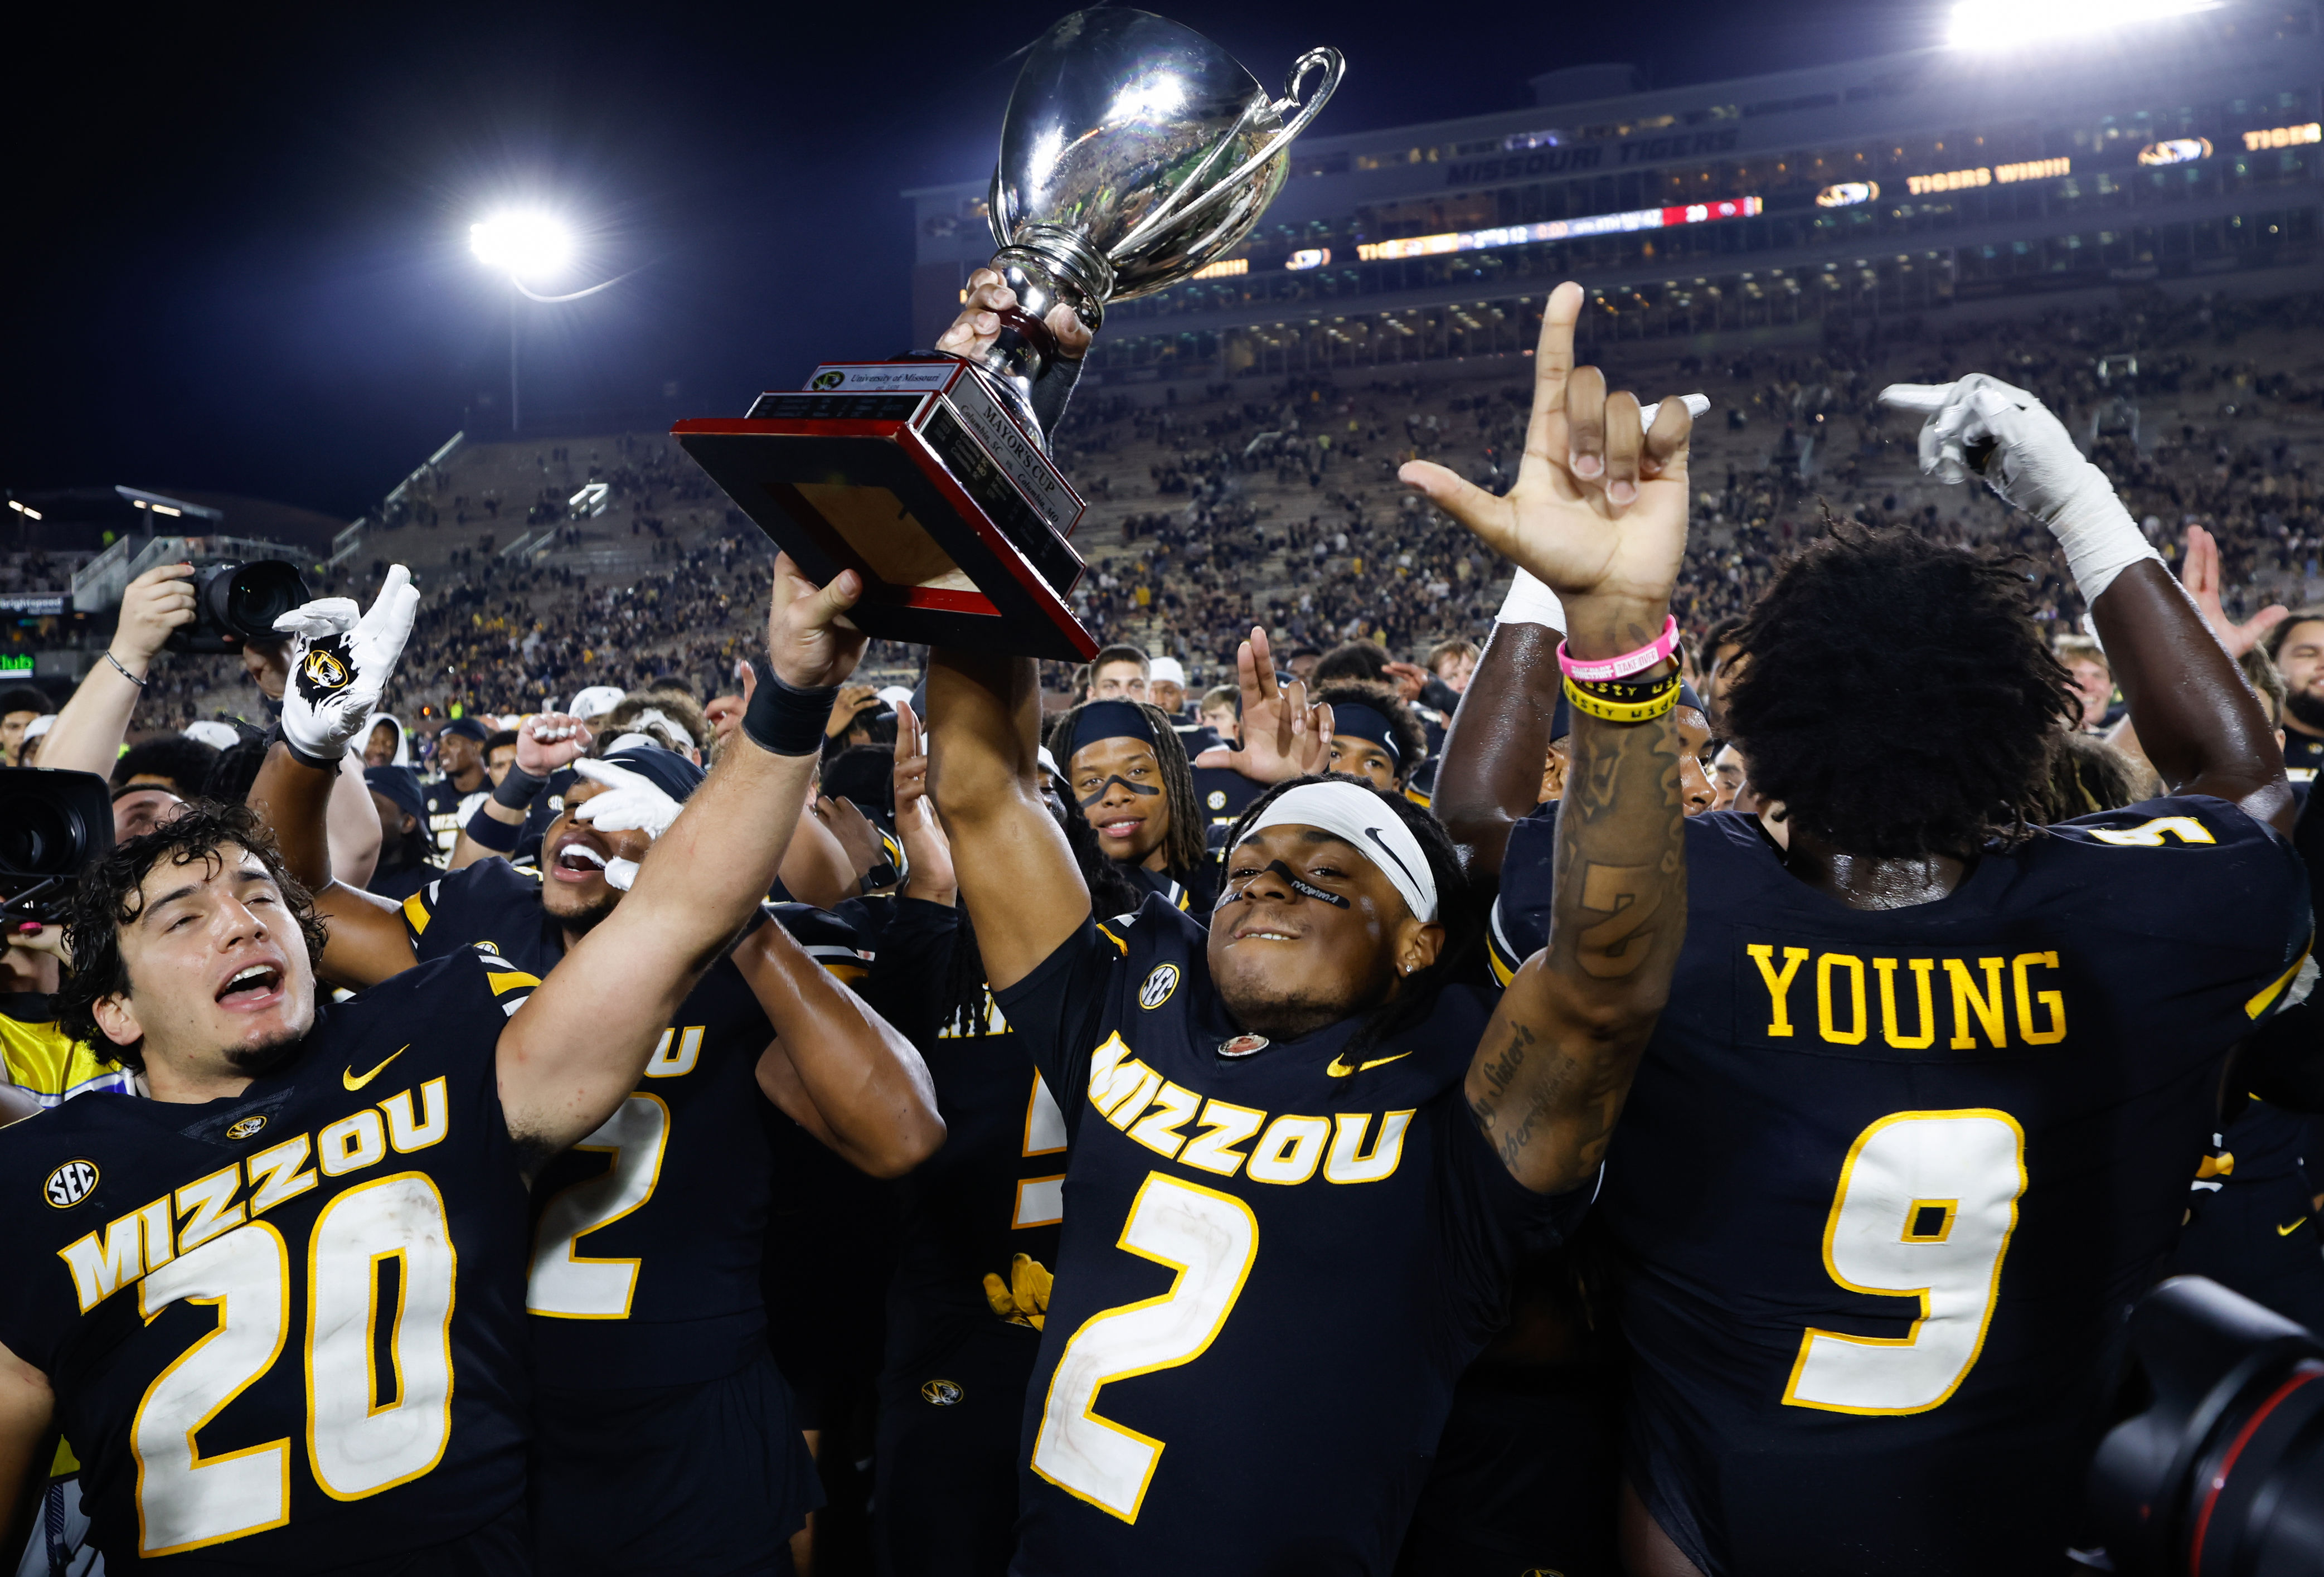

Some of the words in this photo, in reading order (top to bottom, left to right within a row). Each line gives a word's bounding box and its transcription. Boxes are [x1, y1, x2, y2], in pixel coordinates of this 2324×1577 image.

[1446, 147, 1602, 185] MISSOURI
[1620, 129, 1739, 164] TIGERS
[1906, 168, 1992, 195] TIGERS
[1536, 220, 1568, 240] 0:00
[851, 374, 890, 382] University
[902, 373, 941, 382] Missouri
[960, 405, 990, 444] Columbia,
[990, 441, 1003, 454] SC
[1017, 473, 1046, 510] Columbia,
[1045, 507, 1059, 522] MO
[983, 405, 1033, 468] MAYOR'S
[1032, 465, 1055, 493] CUP
[1574, 678, 1637, 696] asty
[1618, 658, 1638, 673] TAKE
[1639, 649, 1657, 666] OVER
[1141, 967, 1176, 1006] SEC
[1746, 943, 2068, 1051] YOUNG
[1088, 1030, 1416, 1186] MIZZOU
[48, 1163, 94, 1205] SEC
[58, 1076, 448, 1316] MIZZOU
[526, 1091, 671, 1320] 2
[1780, 1107, 2028, 1416] 9
[130, 1171, 457, 1560] 20
[1030, 1170, 1259, 1525] 2
